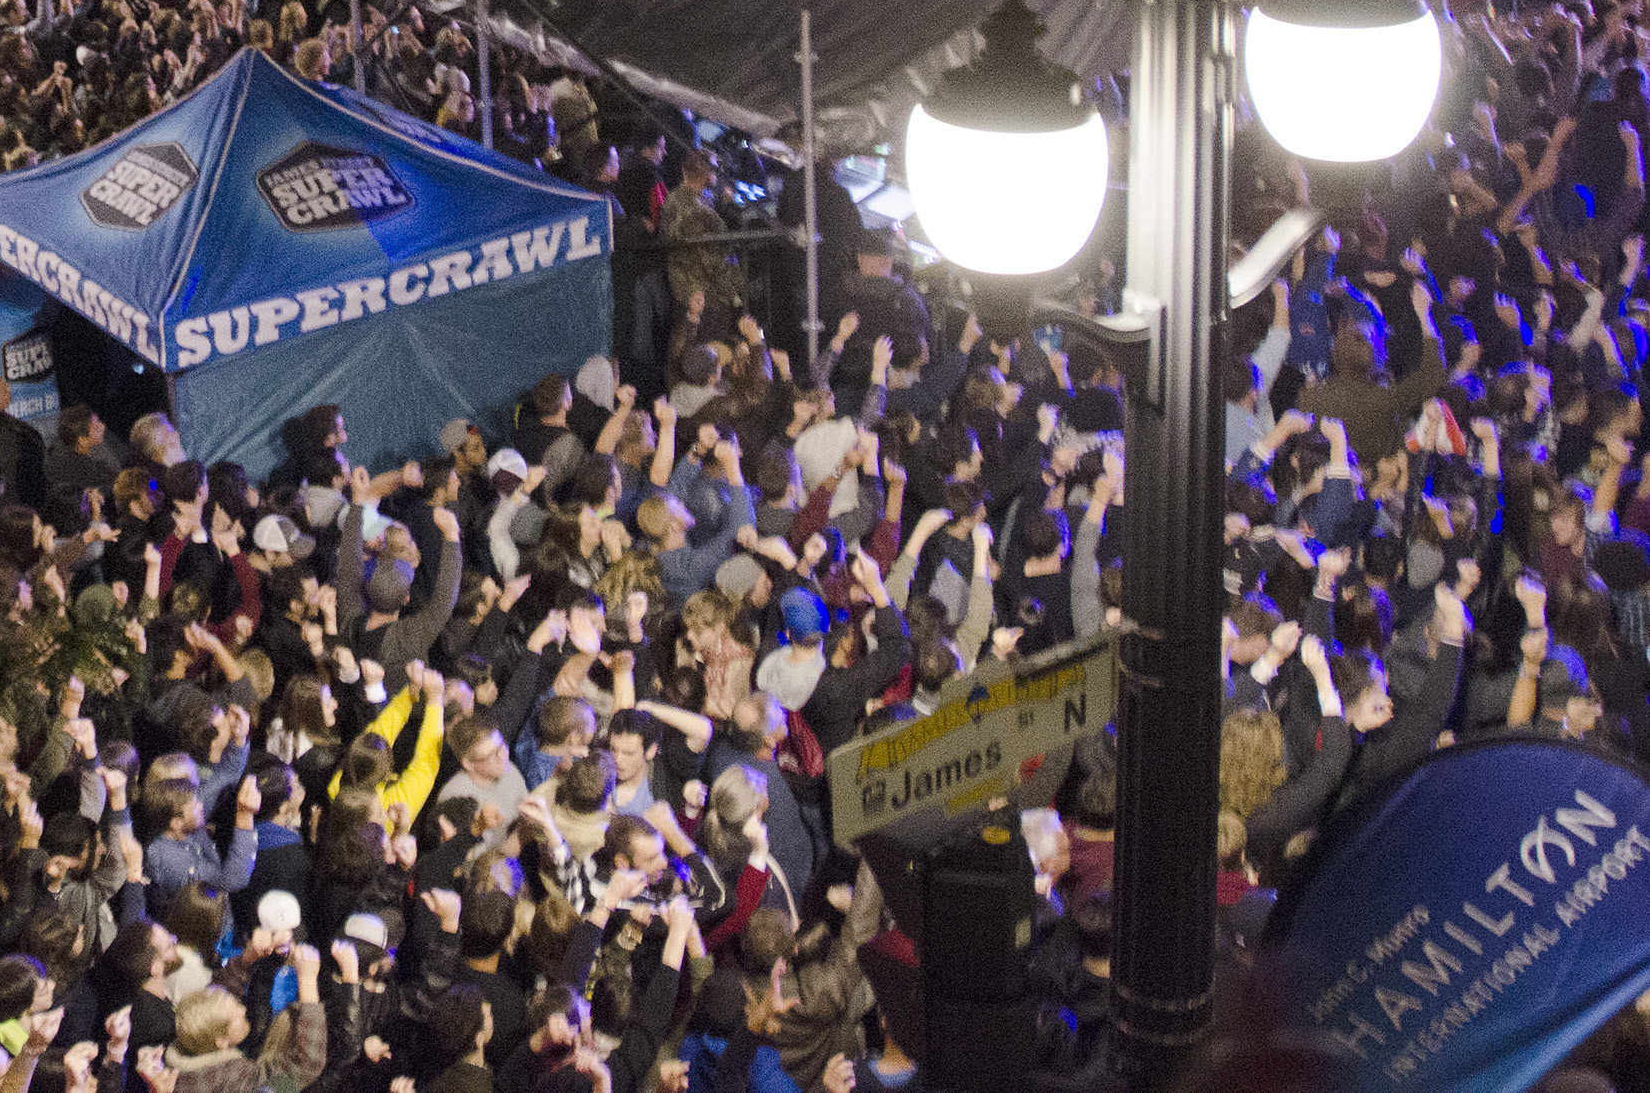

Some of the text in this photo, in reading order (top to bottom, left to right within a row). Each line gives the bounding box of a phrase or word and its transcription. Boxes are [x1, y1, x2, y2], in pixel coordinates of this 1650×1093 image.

[90, 179, 157, 225] CRAWL
[106, 160, 179, 209] SUPER
[272, 167, 394, 208] SUPER
[287, 186, 408, 224] CRAWL
[174, 215, 601, 369] SUPERCRAWL
[891, 741, 1001, 808] James
[1064, 693, 1087, 733] N
[1329, 788, 1617, 1058] HAMILTON
[1366, 904, 1430, 965] Munro
[1384, 825, 1650, 1083] INTERNATIONAL AIRPORT
